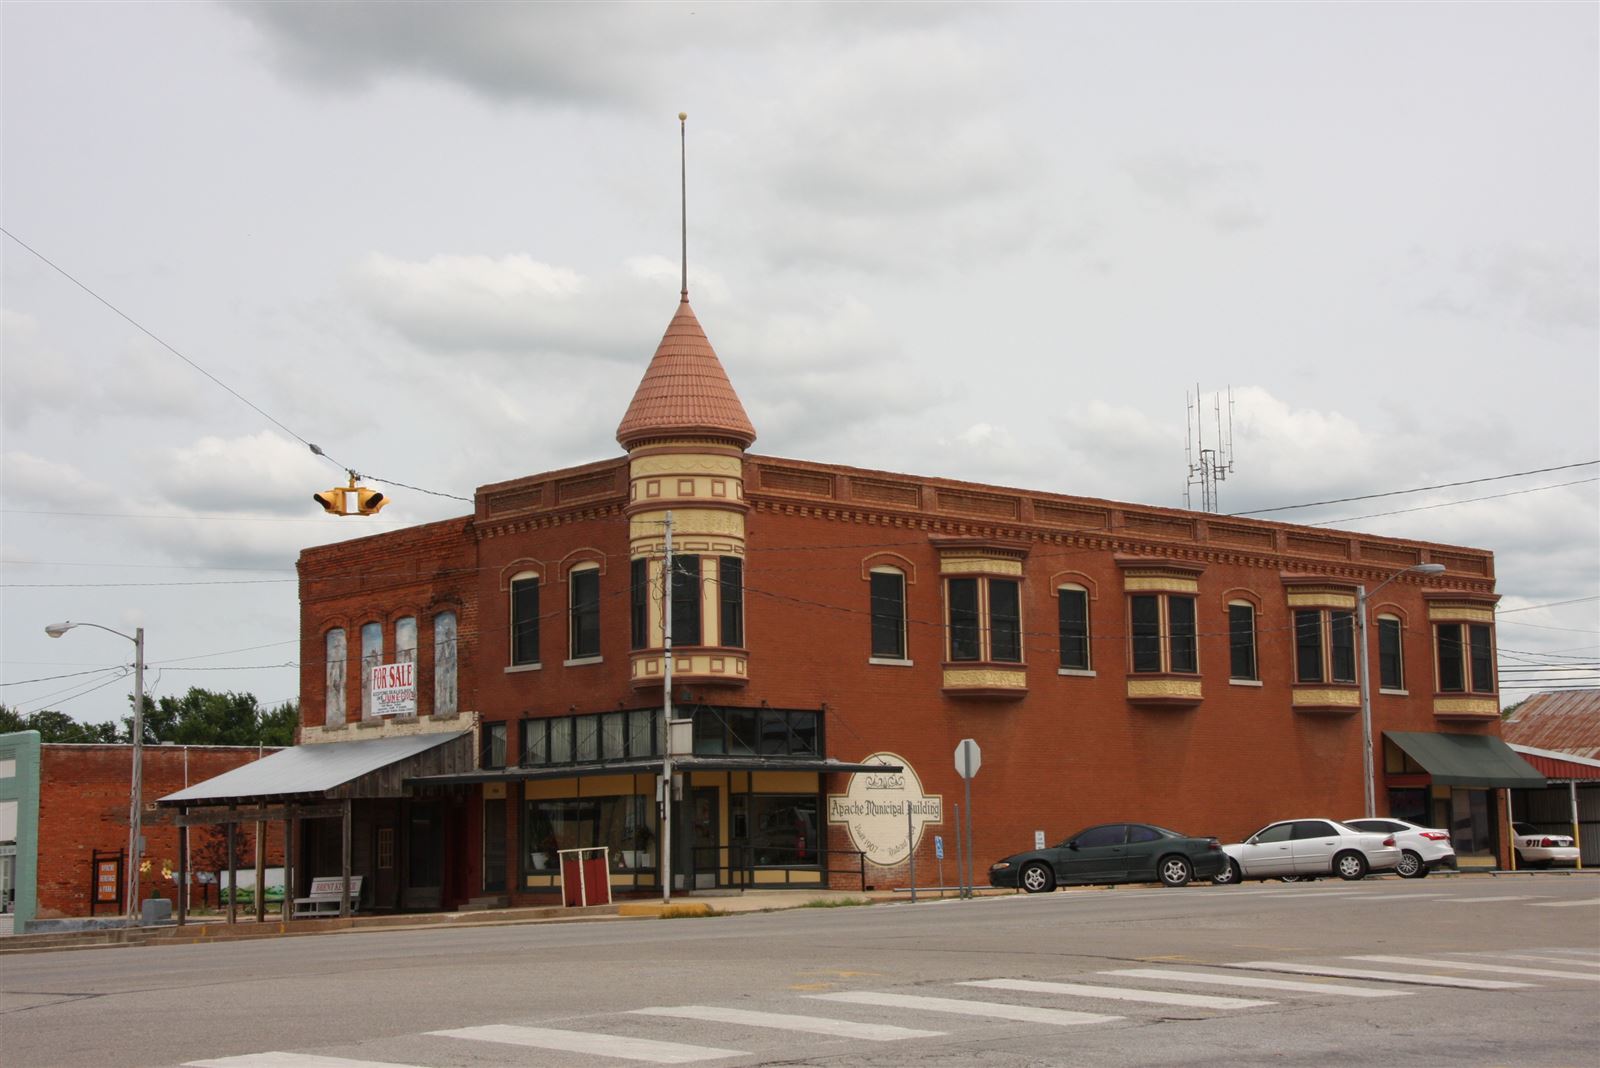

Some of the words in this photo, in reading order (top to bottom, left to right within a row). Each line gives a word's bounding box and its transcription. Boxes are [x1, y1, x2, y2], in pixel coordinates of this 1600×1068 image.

[373, 668, 387, 690] FOR
[389, 665, 412, 687] SALE
[832, 800, 864, 817] Apache
[866, 800, 904, 817] Municipal
[907, 800, 940, 818] Building
[864, 837, 878, 854] 1907
